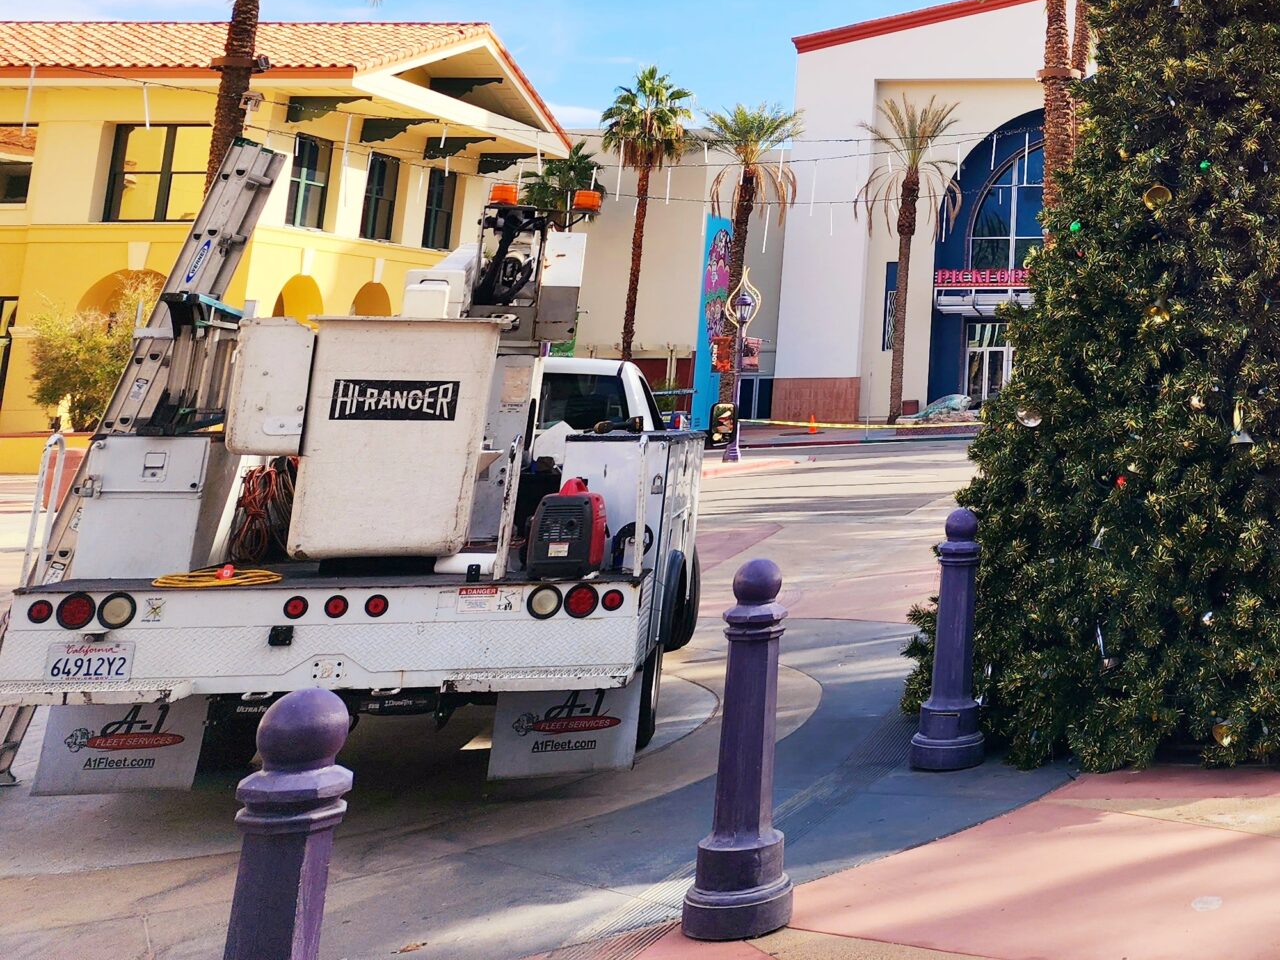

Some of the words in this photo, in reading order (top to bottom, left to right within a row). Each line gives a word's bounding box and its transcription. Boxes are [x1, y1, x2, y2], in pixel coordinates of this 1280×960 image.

[189, 246, 208, 275] WERNER
[334, 380, 454, 419] HI-RANGER
[66, 644, 118, 657] California
[50, 657, 127, 677] 64912Y2
[544, 688, 606, 720] A-1
[100, 704, 170, 737] A-1
[540, 721, 566, 730] FLEET
[568, 719, 611, 729] SERVICES
[94, 738, 123, 747] FLEET
[126, 736, 173, 746] SERVICES
[531, 739, 597, 752] A1Fleet.com
[82, 756, 156, 770] A1Fleet.com
